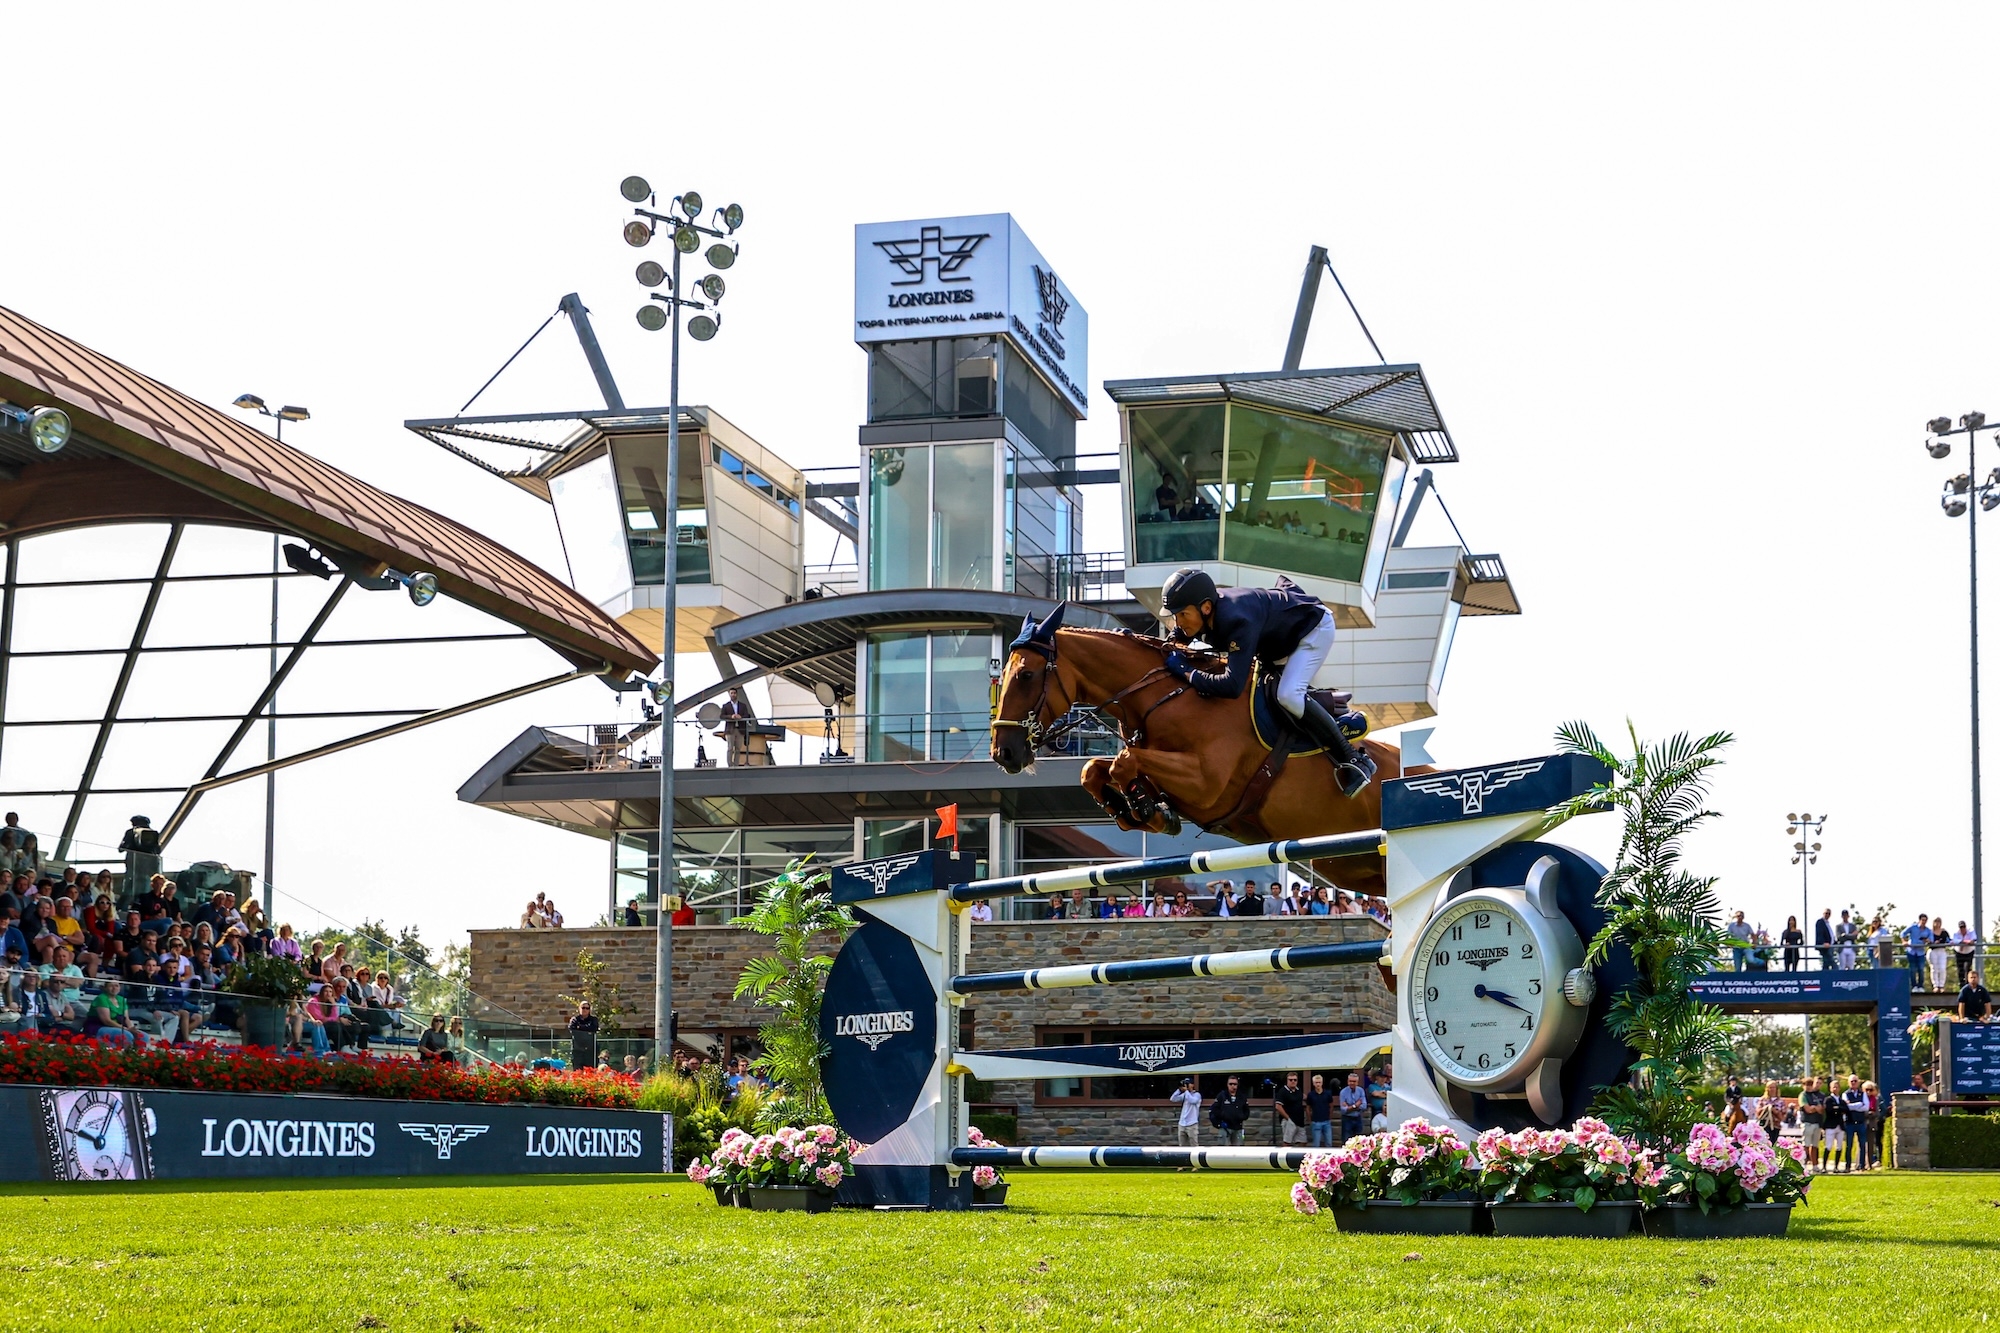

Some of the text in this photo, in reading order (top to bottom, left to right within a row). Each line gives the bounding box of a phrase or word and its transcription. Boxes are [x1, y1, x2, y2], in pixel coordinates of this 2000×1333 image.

[888, 290, 973, 307] LONGINES
[857, 312, 1004, 329] TOPS INTERNATIONAL ARENA
[1474, 913, 1491, 929] 12
[1507, 921, 1512, 936] 1
[1452, 926, 1463, 941] 11
[1435, 951, 1450, 967] 10
[1457, 947, 1509, 961] LONGINES
[1521, 944, 1533, 959] 2
[1427, 986, 1439, 1002] 9
[1528, 979, 1542, 995] 3
[1707, 986, 1800, 994] VALKENSWAARD
[836, 1010, 914, 1036] LONGINES
[1435, 1020, 1447, 1036] 8
[1520, 1015, 1534, 1031] 4
[1118, 1044, 1186, 1061] LONGINES
[1453, 1045, 1465, 1061] 7
[1504, 1042, 1516, 1058] 5
[1478, 1053, 1490, 1069] 6
[202, 1118, 376, 1159] LONGINES
[525, 1126, 641, 1159] LONGINES
